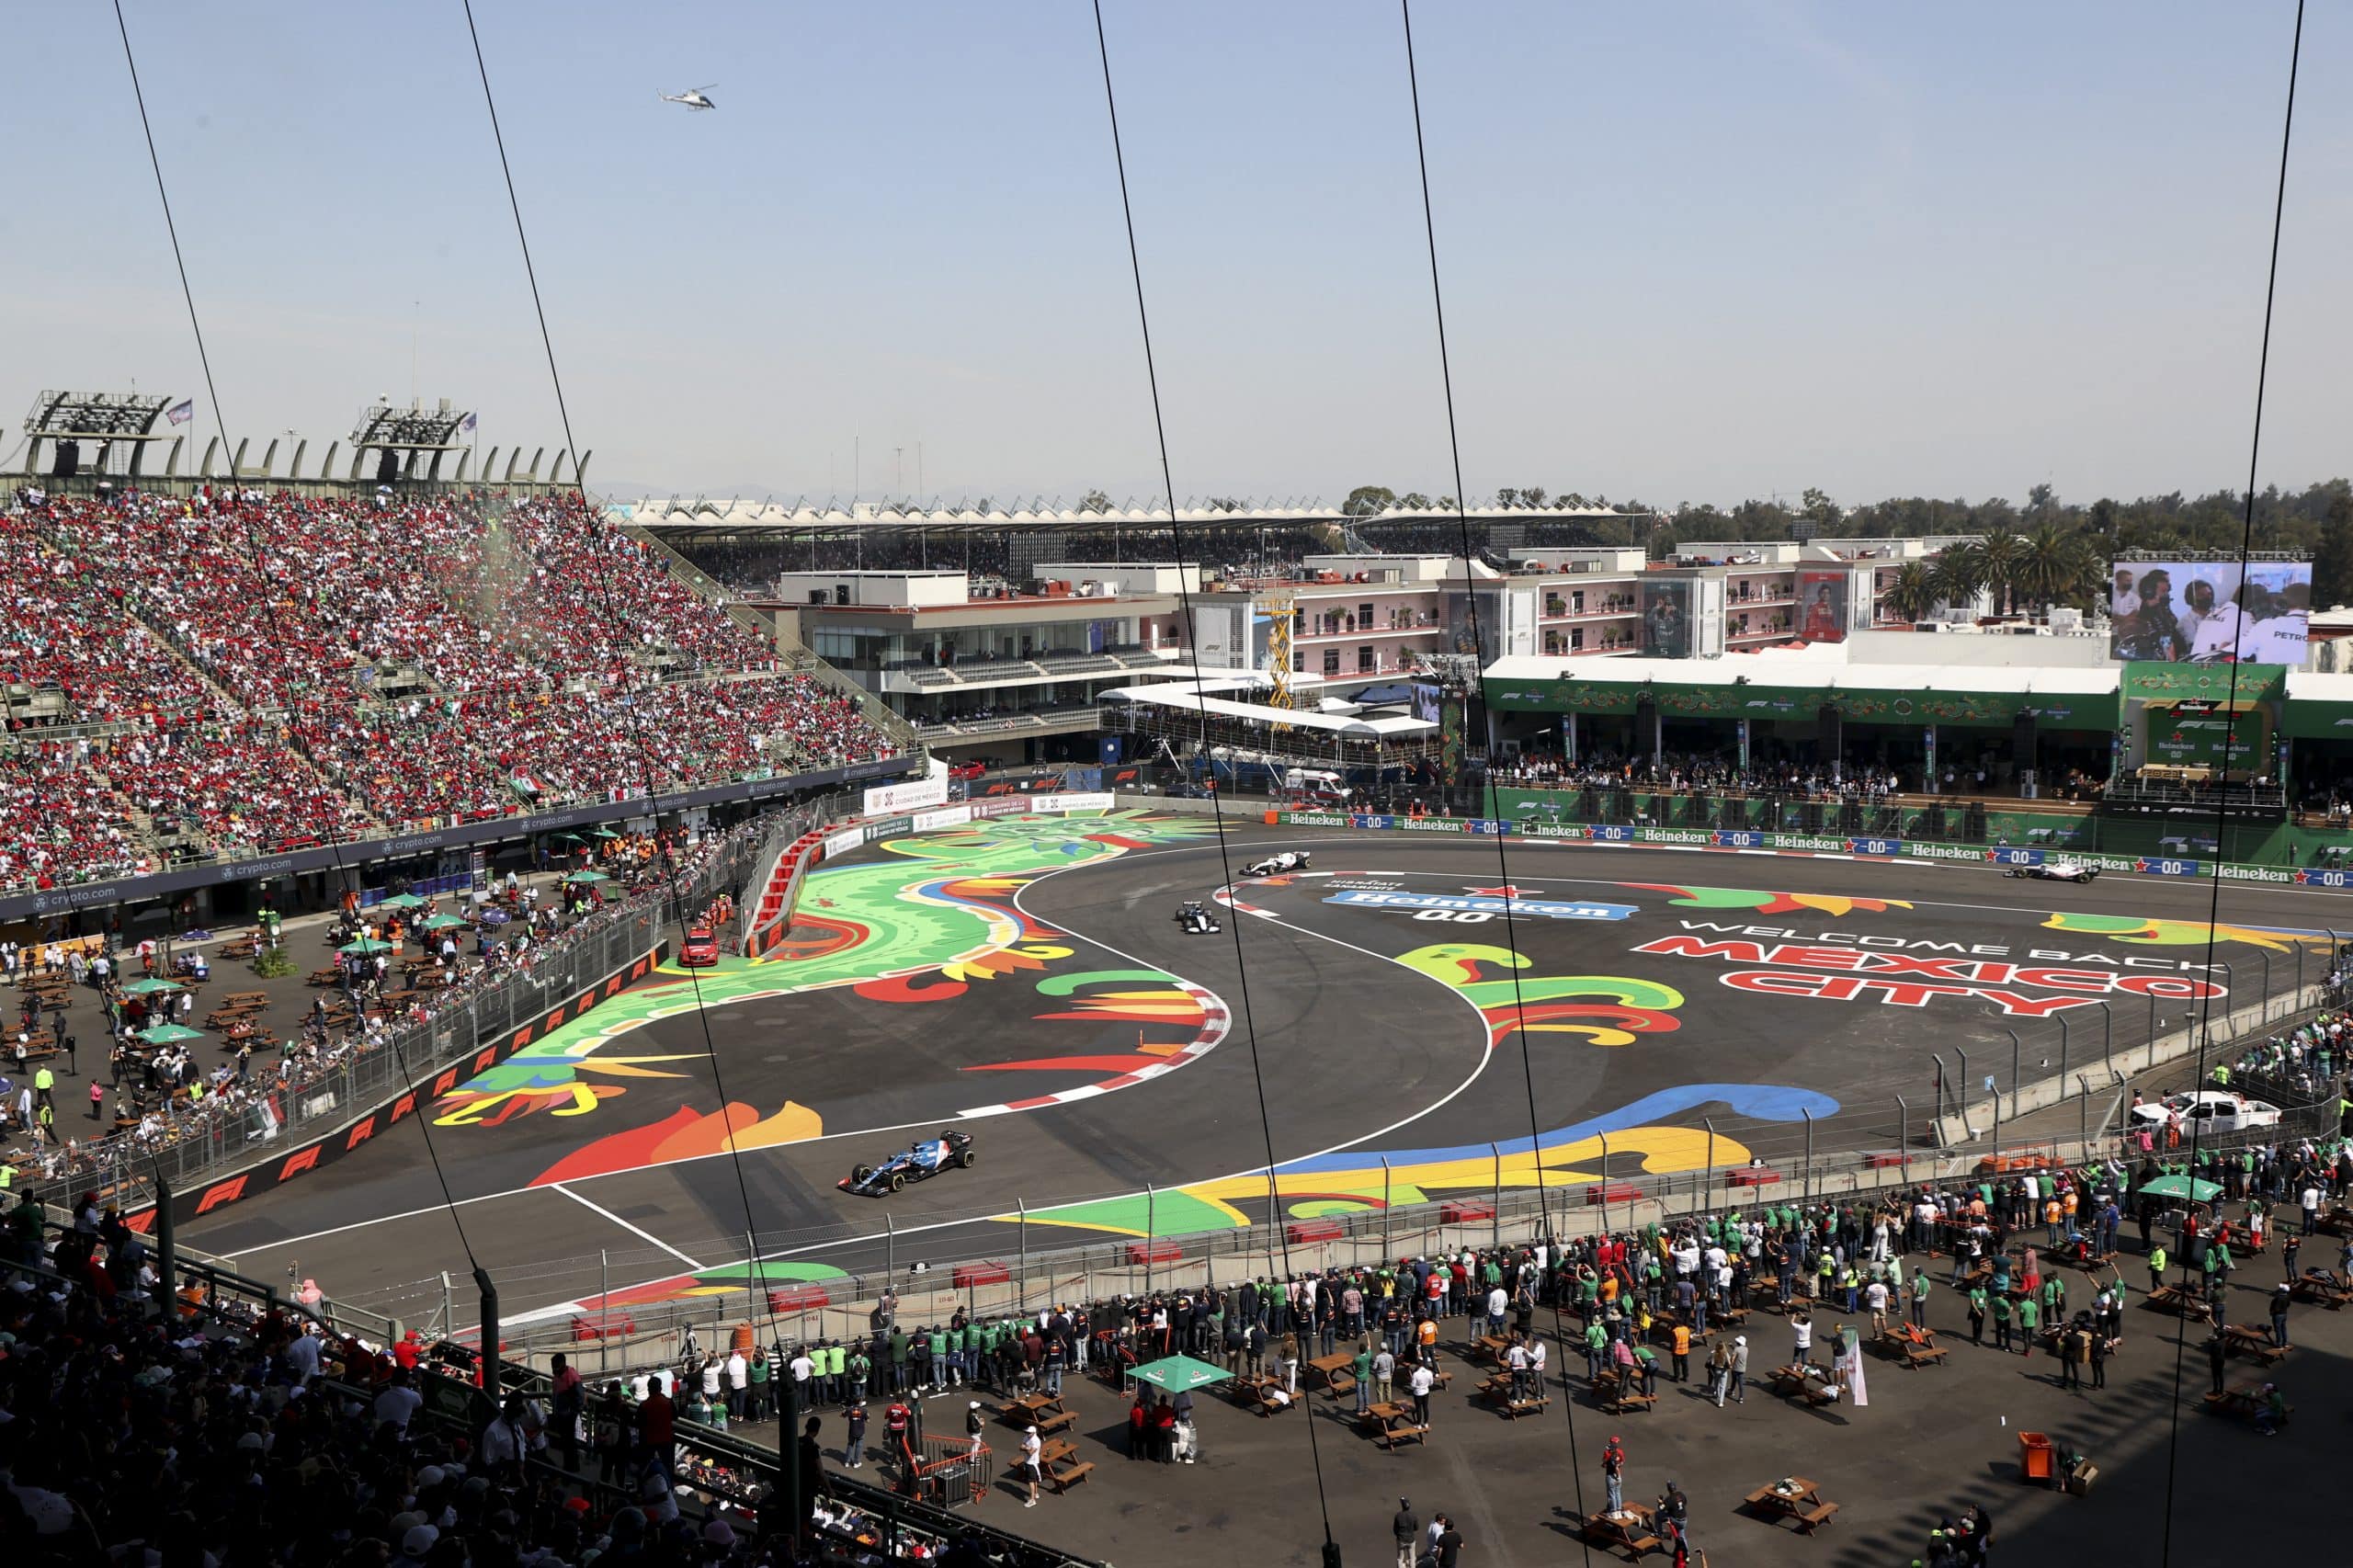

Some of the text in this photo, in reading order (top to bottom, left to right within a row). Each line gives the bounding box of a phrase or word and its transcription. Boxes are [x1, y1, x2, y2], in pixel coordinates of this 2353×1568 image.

[2212, 744, 2250, 752] Heieken
[849, 765, 881, 778] crypto.com
[756, 780, 790, 793] crypto.com
[531, 813, 574, 828] crypto.com
[1290, 812, 1344, 827] Heineken
[1404, 817, 1460, 832] Heineken
[1521, 824, 1580, 837] Hineken
[1644, 828, 1706, 844] Heineken
[394, 834, 443, 851] crypto.com
[1774, 835, 1839, 851] Heineken
[1912, 843, 1981, 860] Heineken
[236, 858, 292, 876] crypto.com
[2057, 853, 2130, 871] Heineken
[2211, 863, 2289, 882] Heineken
[51, 886, 116, 907] crypto.com
[1345, 891, 1610, 917] Heineken
[1678, 919, 2229, 974] WELCOME BACK
[1628, 934, 2230, 1001] MÉXICO
[1719, 970, 2111, 1018] CITY
